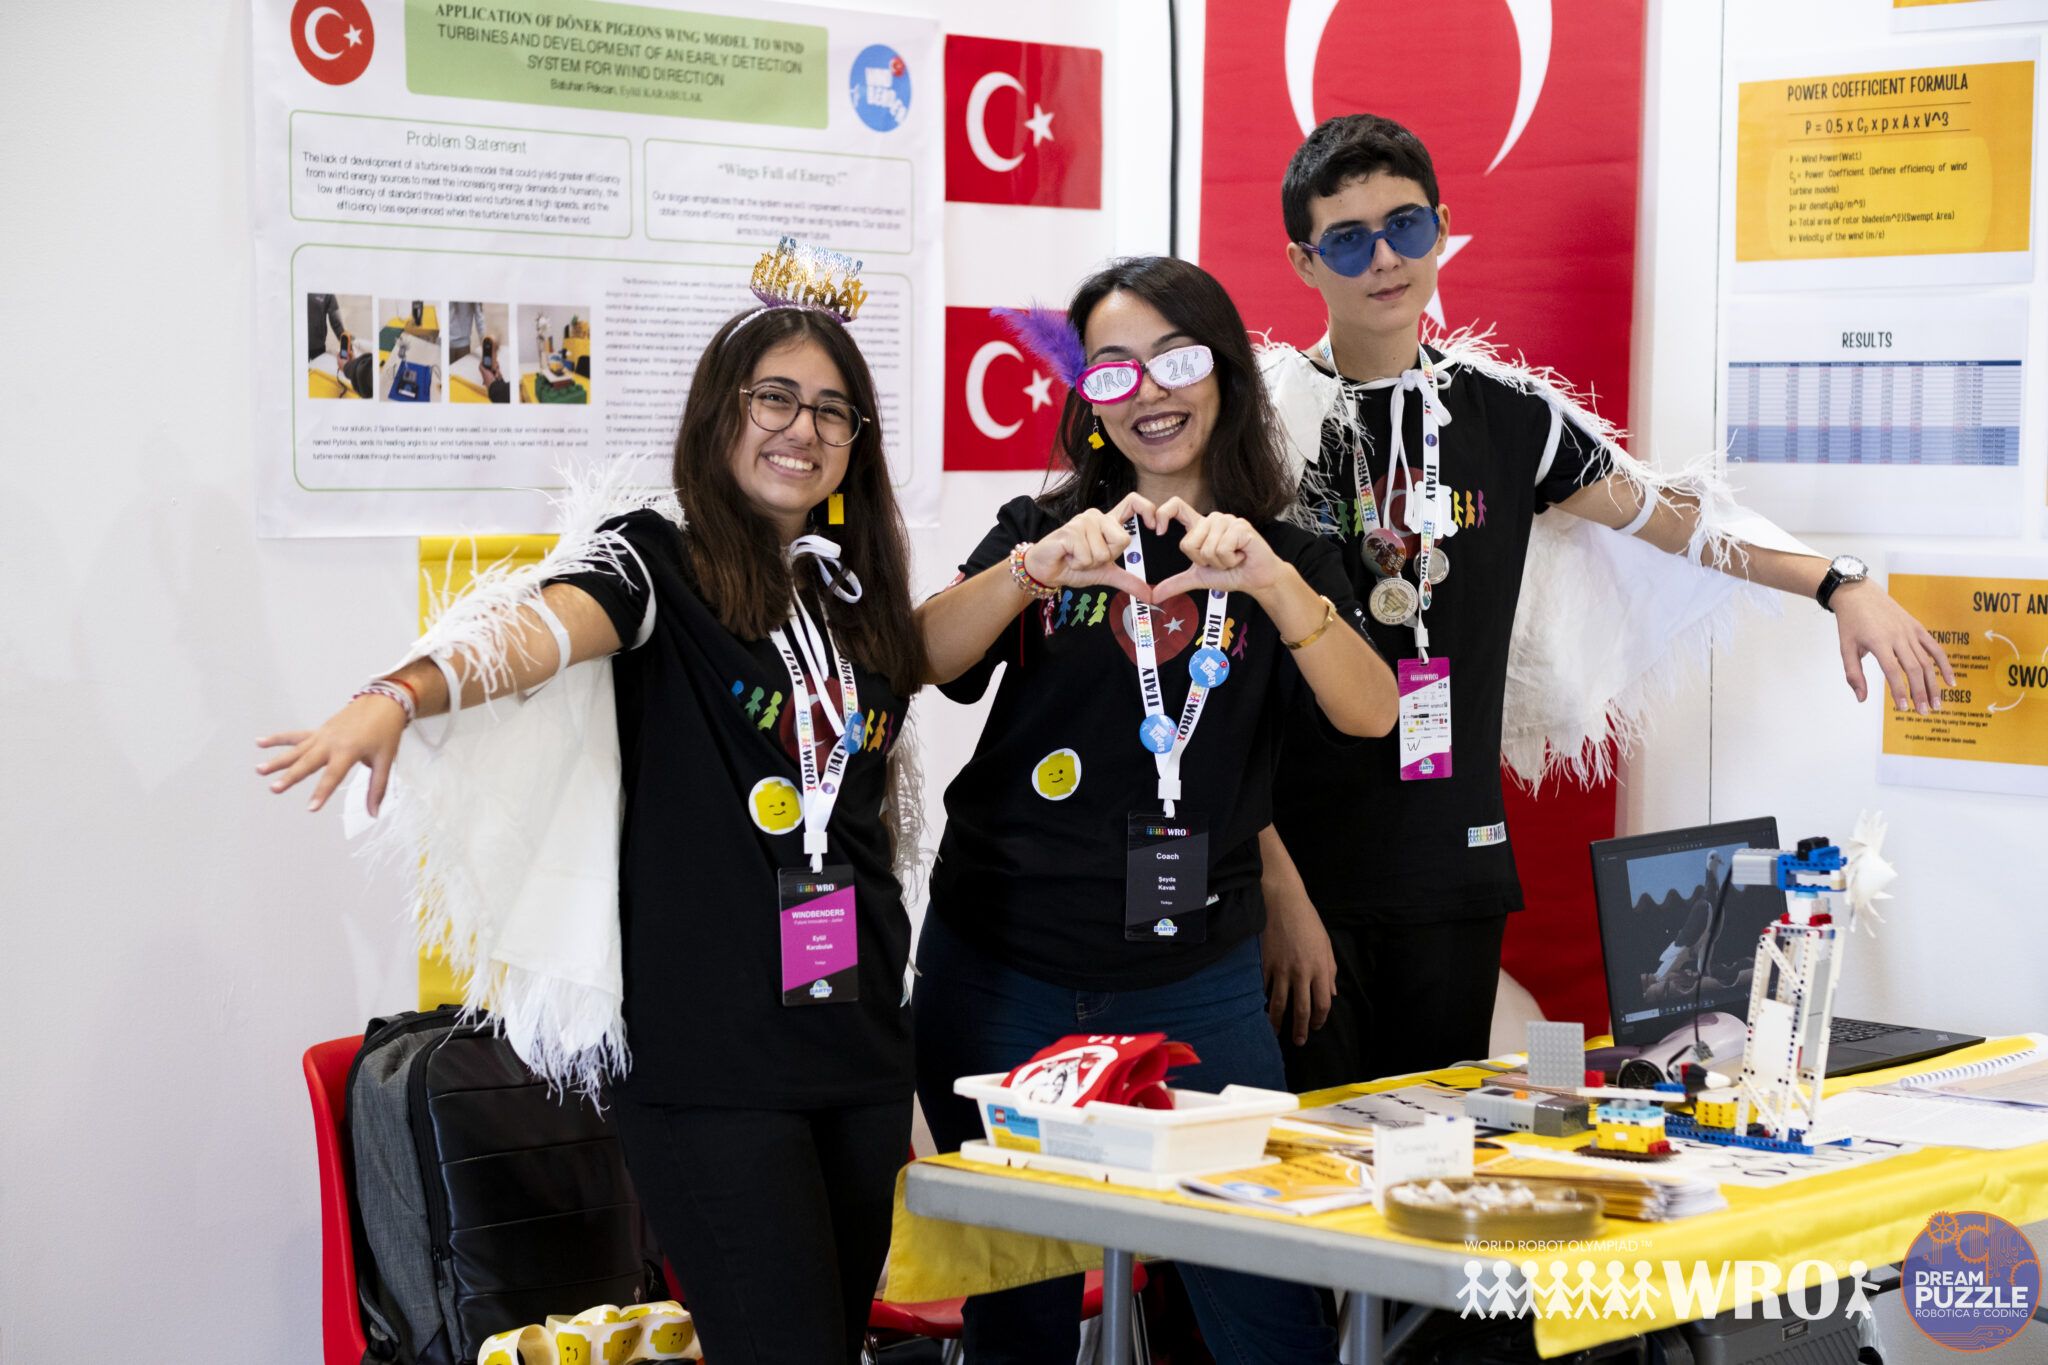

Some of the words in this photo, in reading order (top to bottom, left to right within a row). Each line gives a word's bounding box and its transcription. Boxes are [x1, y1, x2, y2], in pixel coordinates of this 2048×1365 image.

[436, 4, 531, 24] APPLICATION
[535, 14, 552, 28] OF
[606, 21, 661, 39] PIGEONS
[665, 28, 700, 43] WING
[704, 32, 749, 49] MODEL
[753, 37, 769, 50] TO
[772, 39, 804, 54] WIND
[438, 24, 508, 44] TURBINES
[510, 32, 540, 48] AND
[543, 34, 642, 58] DEVELOPMENT
[644, 45, 661, 60] OF
[666, 49, 683, 63] AN
[687, 50, 728, 67] EARLY
[732, 55, 802, 74] DETECTION
[527, 54, 580, 73] SYSTEM
[585, 60, 611, 76] FOR
[614, 63, 650, 80] WIND
[653, 66, 724, 86] DIRECTION
[1787, 83, 1827, 102] POWER
[1832, 77, 1906, 98] COEFFICIENT
[1911, 72, 1968, 94] FORMULA
[1806, 121, 1812, 134] P
[1826, 118, 1843, 134] 0.5
[1902, 114, 1909, 129] A
[406, 130, 460, 148] Problem
[465, 135, 527, 154] Statement
[1805, 170, 1824, 179] Power
[1829, 168, 1864, 178] Coefficient
[1900, 164, 1935, 174] efficiency
[1938, 162, 1946, 172] of
[1951, 162, 1968, 171] wind
[1842, 331, 1893, 349] RESULTS
[1084, 367, 1131, 397] WRO
[1426, 464, 1437, 502] ITALY
[1973, 591, 2021, 613] SWOT
[783, 649, 805, 688] ITALY
[1142, 667, 1160, 707] ITALY
[1178, 703, 1199, 735] WRO
[802, 750, 816, 785] WRO
[827, 741, 848, 776] ITAL
[1167, 828, 1187, 836] WRO
[1156, 852, 1179, 860] Coach
[816, 884, 834, 892] WRO
[792, 909, 845, 919] WINDBENDERS
